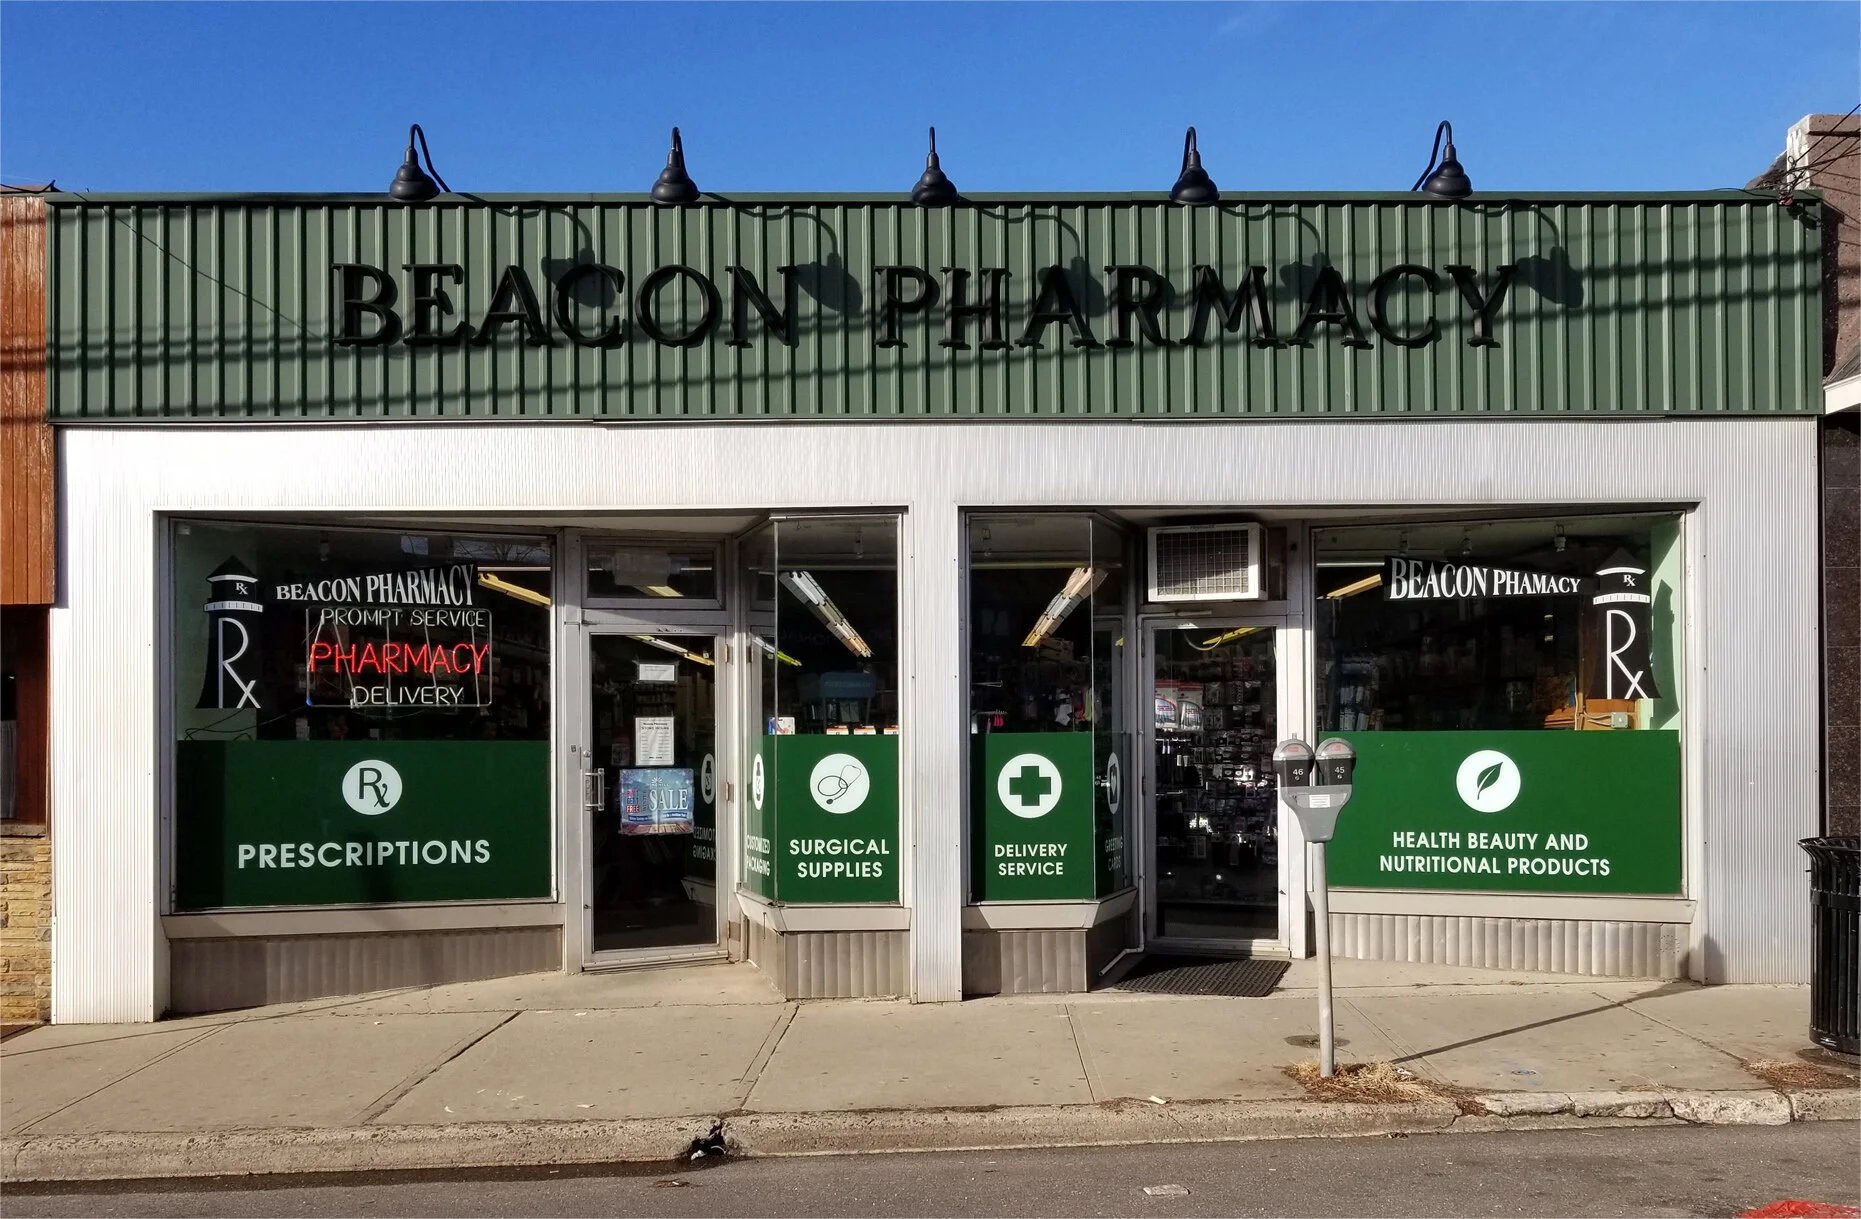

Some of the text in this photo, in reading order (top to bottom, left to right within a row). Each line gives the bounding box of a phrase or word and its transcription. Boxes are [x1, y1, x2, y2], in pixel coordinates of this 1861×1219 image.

[331, 262, 1519, 349] BEACON PHARMACY
[276, 564, 475, 606] BEACON PHARMACY
[1389, 557, 1582, 600] BEACON PHAMACY
[321, 607, 487, 628] PROMPT SERVICE
[310, 641, 490, 674] PHARMACY
[351, 685, 465, 706] DELIVERY
[1292, 768, 1304, 776] 46
[1334, 766, 1345, 774] 45
[626, 805, 639, 813] FREE
[648, 788, 689, 811] SALE
[789, 838, 890, 855] SURGICAL
[994, 843, 1068, 858] DELIVERY
[1393, 831, 1588, 851] HEALTH BEAUTY AND
[237, 839, 491, 869] PRESCRIPTIONS
[797, 861, 883, 878] SUPPLIES
[998, 861, 1064, 876] SERVICE
[1379, 855, 1610, 876] NUTRITIONAL PRODUCTS
